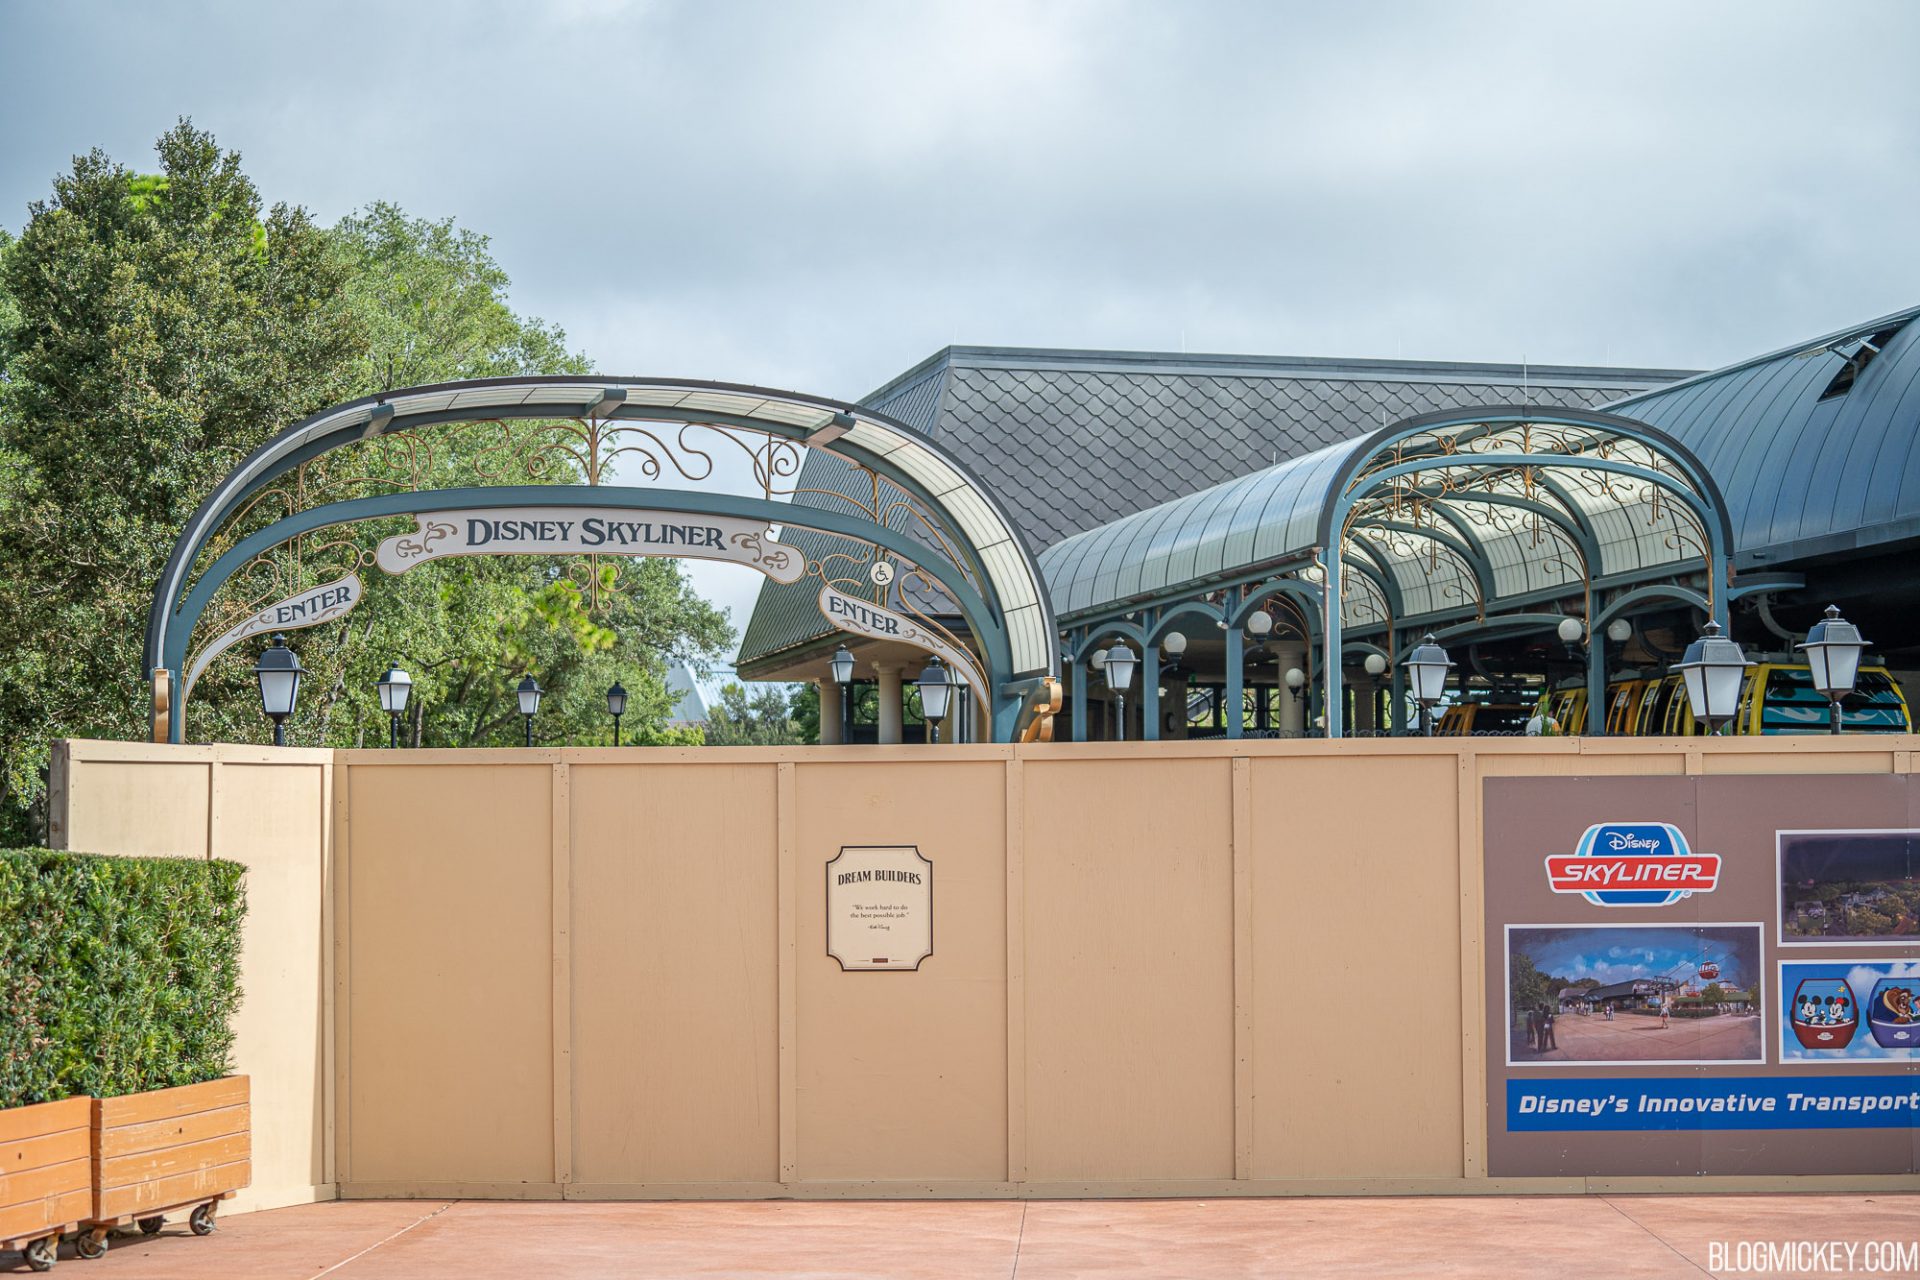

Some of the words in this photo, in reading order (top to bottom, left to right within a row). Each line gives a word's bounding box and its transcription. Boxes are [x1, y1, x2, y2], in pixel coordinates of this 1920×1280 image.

[466, 518, 574, 547] DISNEY
[580, 518, 726, 550] SKYLINER
[276, 586, 352, 624] ENTER
[828, 595, 900, 635] ENTER
[1605, 831, 1660, 854] Disney
[838, 870, 872, 886] DREAM
[875, 869, 922, 885] BUILDERS
[1564, 861, 1703, 885] SKYLINER
[1518, 1095, 1628, 1117] Disney's
[1638, 1094, 1776, 1113] Innovative
